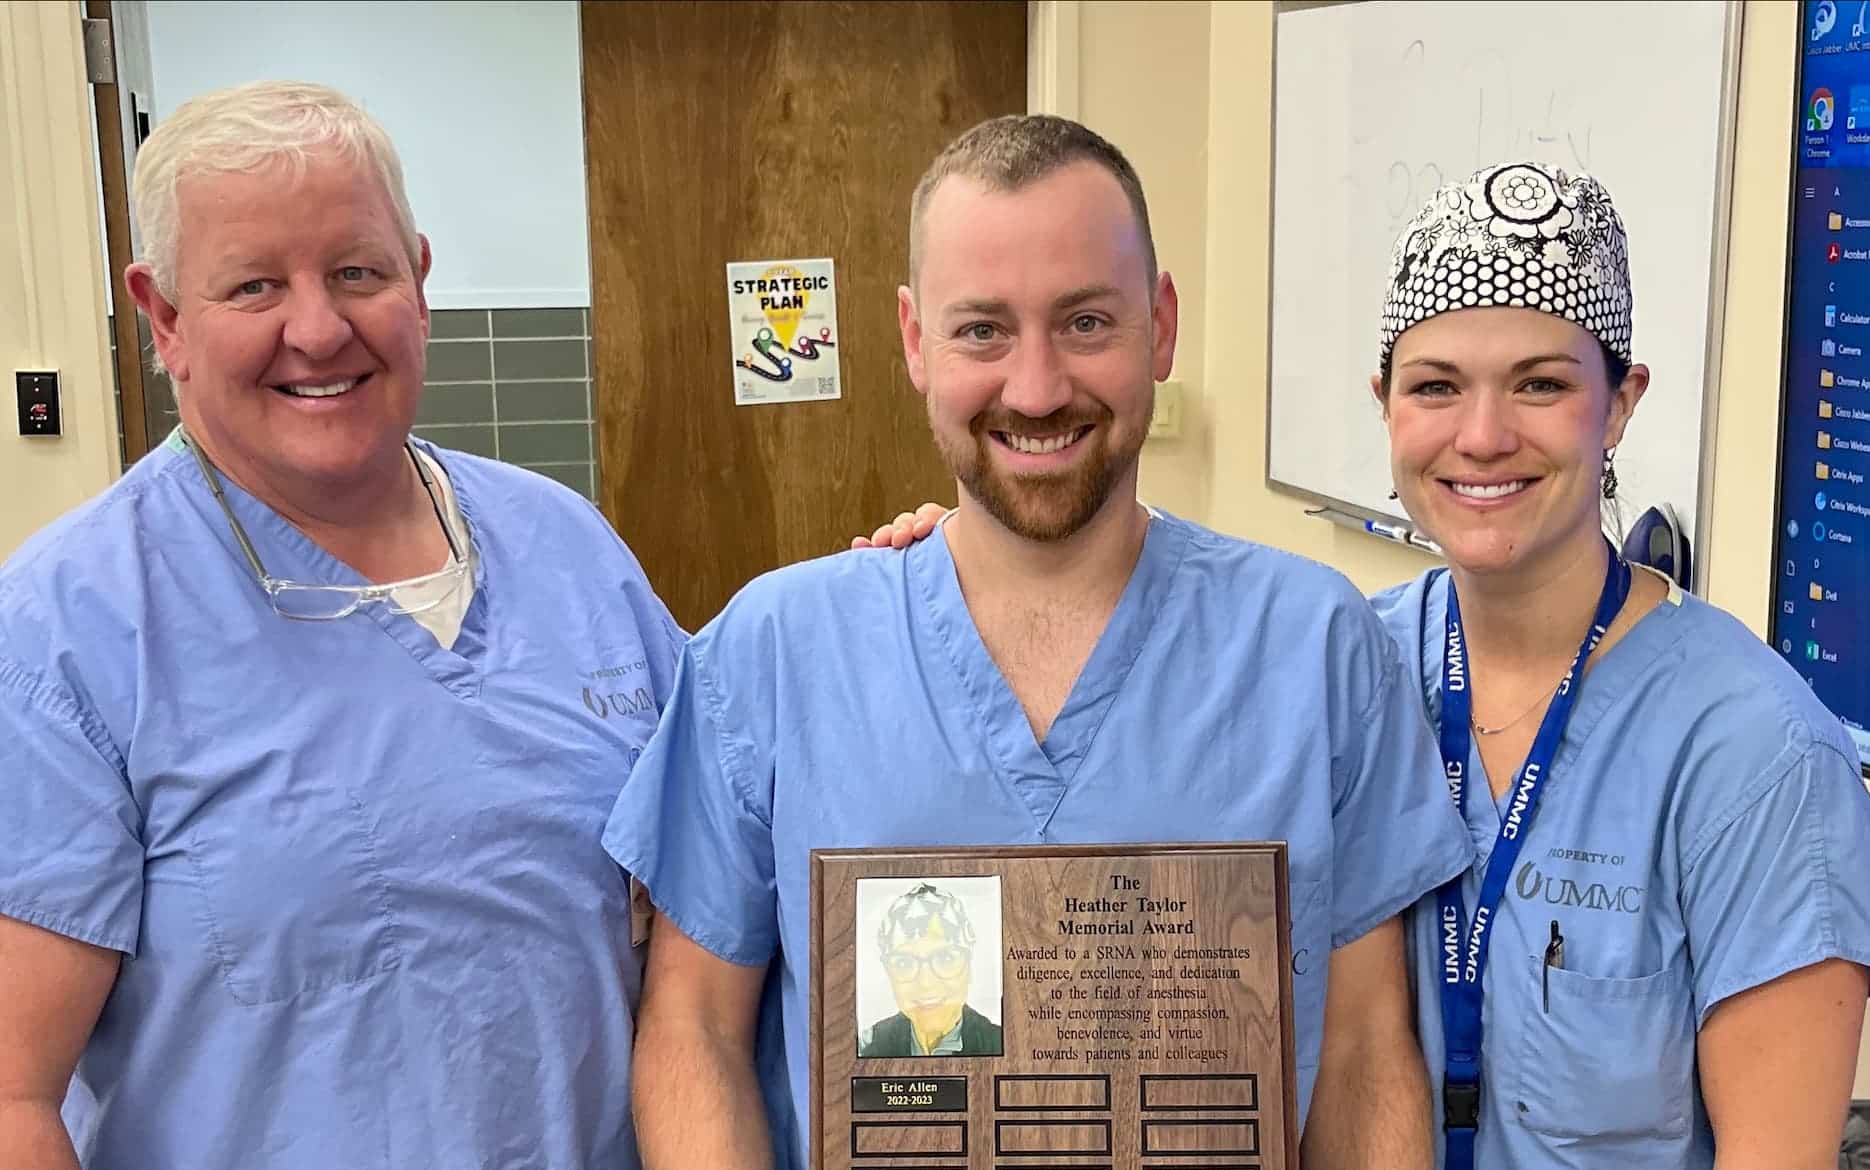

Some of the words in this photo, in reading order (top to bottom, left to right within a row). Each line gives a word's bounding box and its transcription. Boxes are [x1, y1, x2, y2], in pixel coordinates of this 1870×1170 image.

[1834, 186, 1841, 197] A
[733, 276, 829, 294] STRATEGIC
[1828, 281, 1835, 293] C
[760, 296, 804, 310] PLAN
[1838, 344, 1862, 356] Camera
[1825, 589, 1838, 601] Dell
[1503, 762, 1541, 841] UMMC
[1110, 875, 1141, 890] The
[1543, 877, 1641, 913] UMMC
[1064, 897, 1128, 913] Heather
[1136, 897, 1187, 916] Taylor
[1058, 920, 1134, 935] Memorial
[1142, 920, 1194, 935] Award
[1443, 905, 1460, 984] UMMC
[1465, 906, 1490, 984] UMMC
[1007, 946, 1058, 960] Awarded
[1064, 947, 1076, 960] to
[1083, 950, 1090, 960] a
[1096, 945, 1135, 960] SRNA
[1142, 945, 1167, 960] who
[1173, 945, 1250, 959] demonstrates
[1016, 966, 1073, 983] diligence,
[1080, 965, 1145, 981] excellence,
[1151, 966, 1173, 979] and
[1180, 965, 1240, 979] dedication
[1051, 988, 1063, 1000] to
[1070, 986, 1087, 999] the
[1095, 986, 1121, 999] field
[1127, 986, 1142, 999] of
[1147, 985, 1207, 999] anesthesia
[1028, 1006, 1062, 1019] while
[1068, 1006, 1151, 1023] encompassing
[1140, 1026, 1161, 1039] and
[1168, 1026, 1203, 1039] virtue
[1032, 1046, 1079, 1060] towards
[1086, 1046, 1131, 1063] patients
[1138, 1046, 1159, 1060] and
[1166, 1045, 1229, 1063] colleagues
[881, 1082, 904, 1093] Eric
[908, 1082, 938, 1093] Allen
[887, 1095, 933, 1105] 2022-2023
